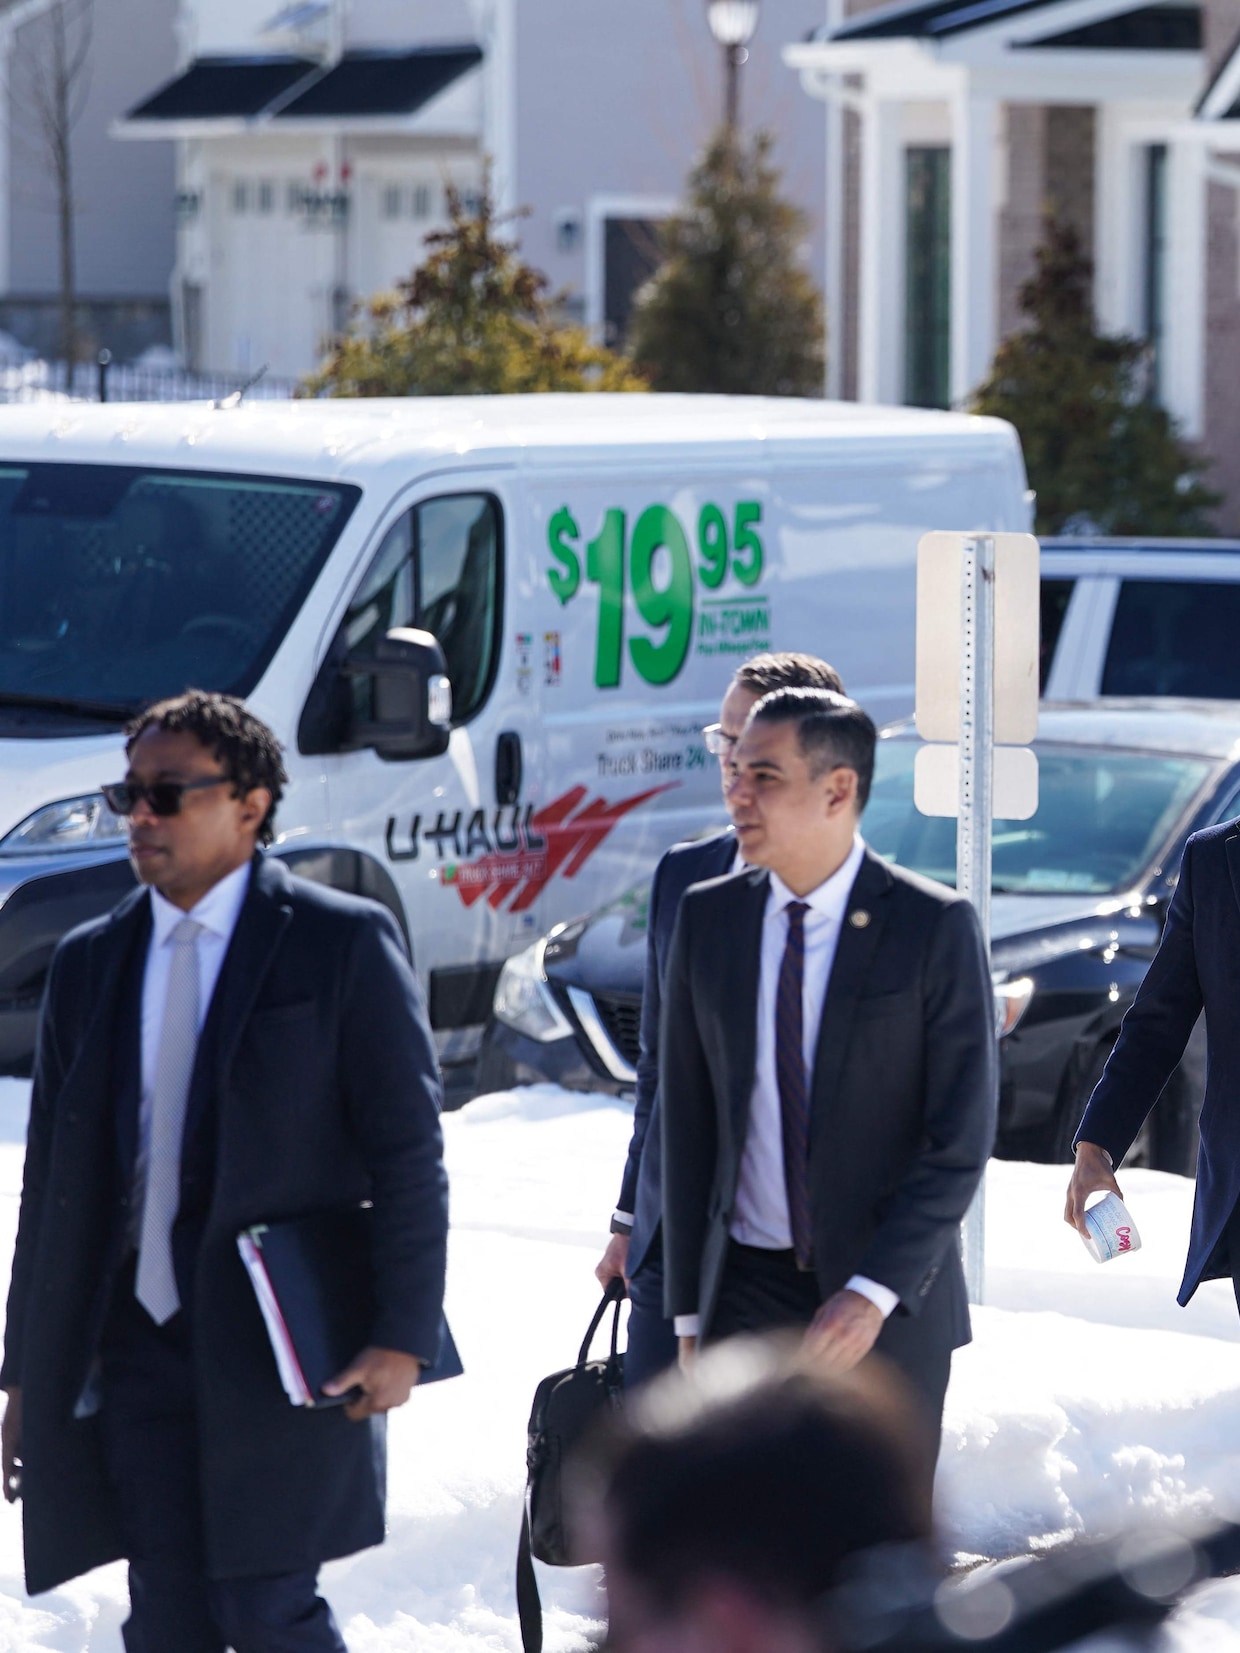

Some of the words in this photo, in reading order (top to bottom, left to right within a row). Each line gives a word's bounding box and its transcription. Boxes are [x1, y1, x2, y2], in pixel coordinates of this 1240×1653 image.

[597, 751, 636, 776] Truck
[641, 747, 683, 774] Share
[386, 803, 545, 861] U-HAUL
